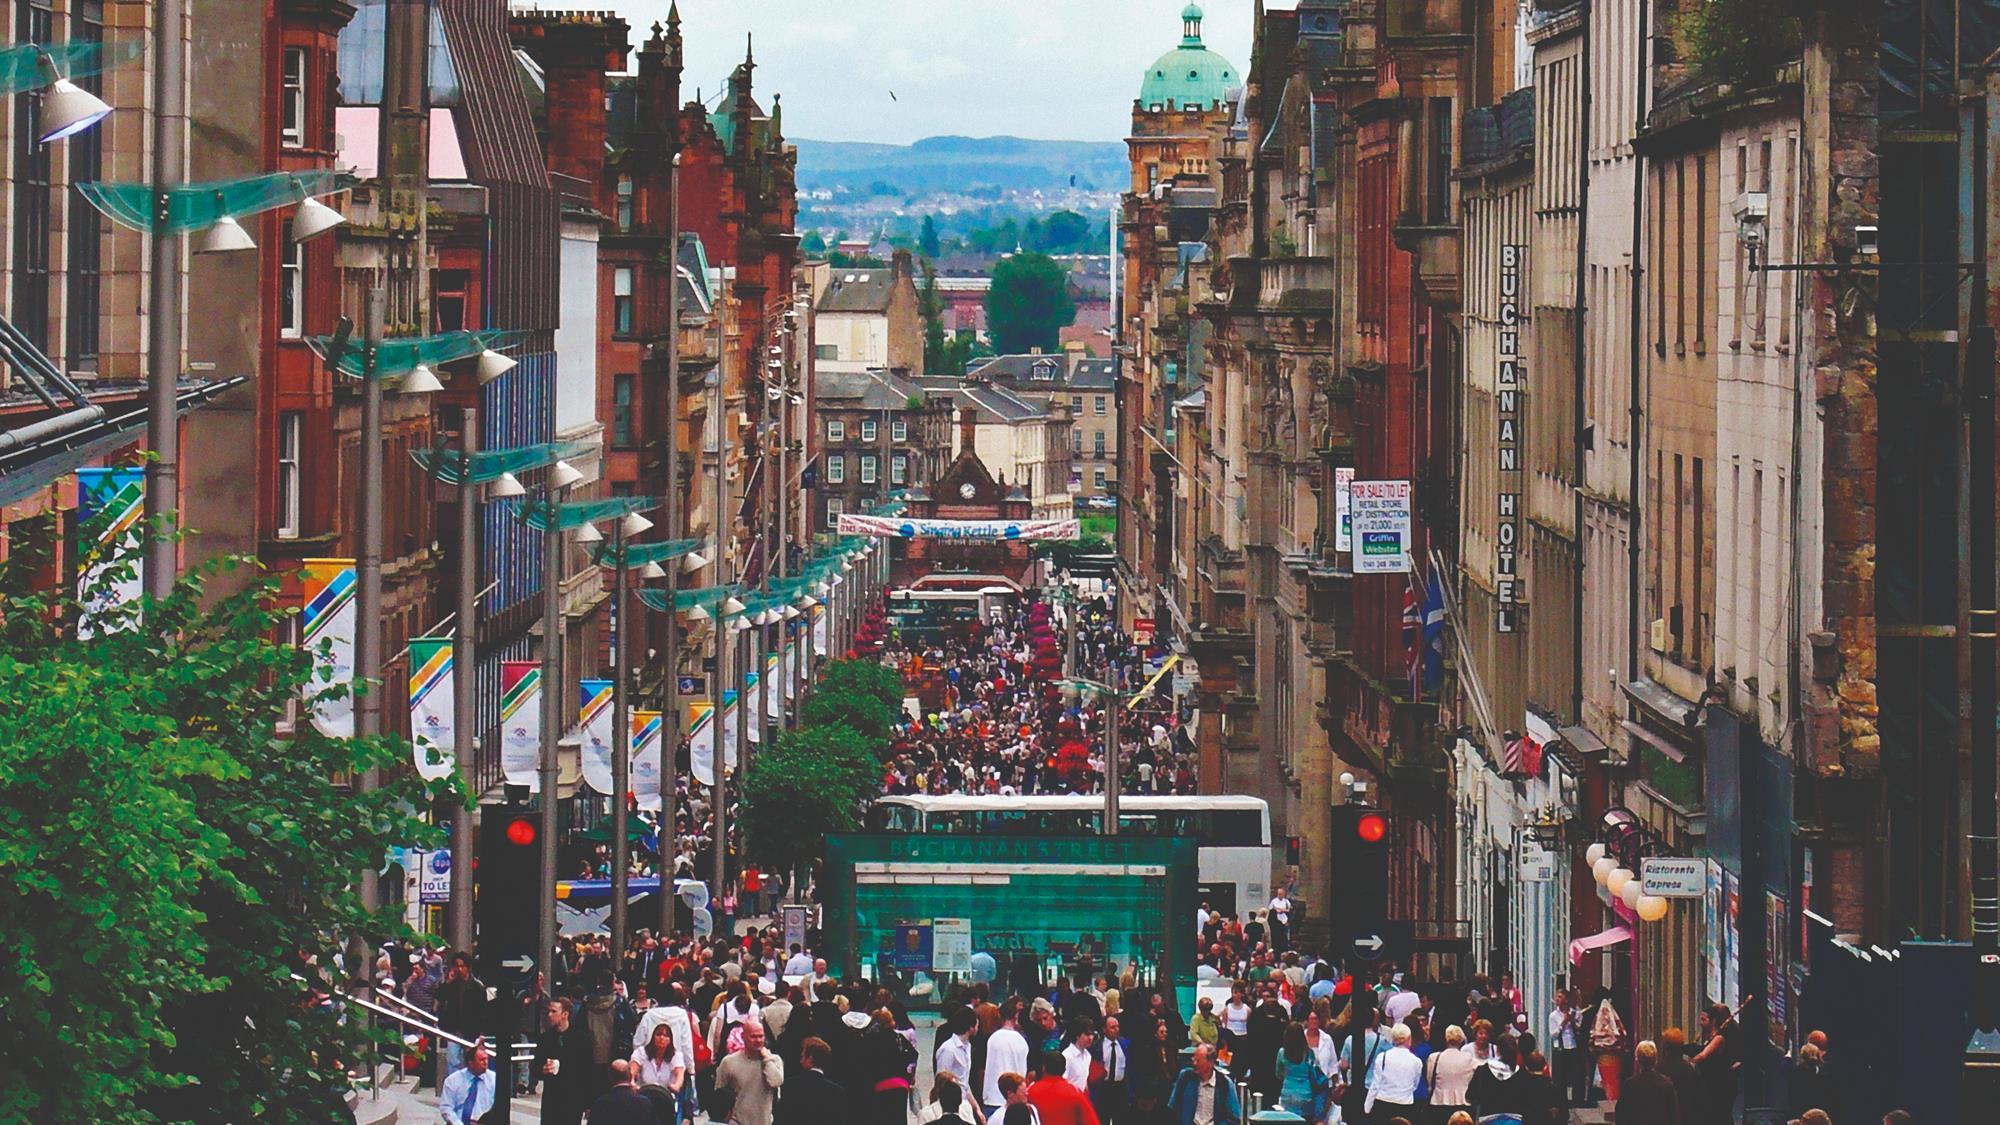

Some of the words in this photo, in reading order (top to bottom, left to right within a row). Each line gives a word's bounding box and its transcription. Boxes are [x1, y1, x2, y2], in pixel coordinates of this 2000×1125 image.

[1500, 245, 1516, 470] BUCHANAN
[1352, 484, 1365, 498] FOR
[1397, 484, 1408, 497] LET
[1359, 500, 1379, 509] RETAIL
[1382, 500, 1402, 508] STORE
[1353, 511, 1362, 519] OF
[1366, 510, 1409, 518] DISTINCTION
[920, 522, 961, 539] Singing
[963, 524, 998, 537] Kettle
[1369, 534, 1394, 543] Griffin
[1366, 545, 1398, 554] Webster
[1499, 494, 1514, 632] HOTEL
[889, 841, 1028, 858] BUCHANAN
[1039, 842, 1133, 858] STREET
[1645, 864, 1696, 874] Ristorante
[423, 882, 435, 891] TO
[437, 882, 449, 891] LE
